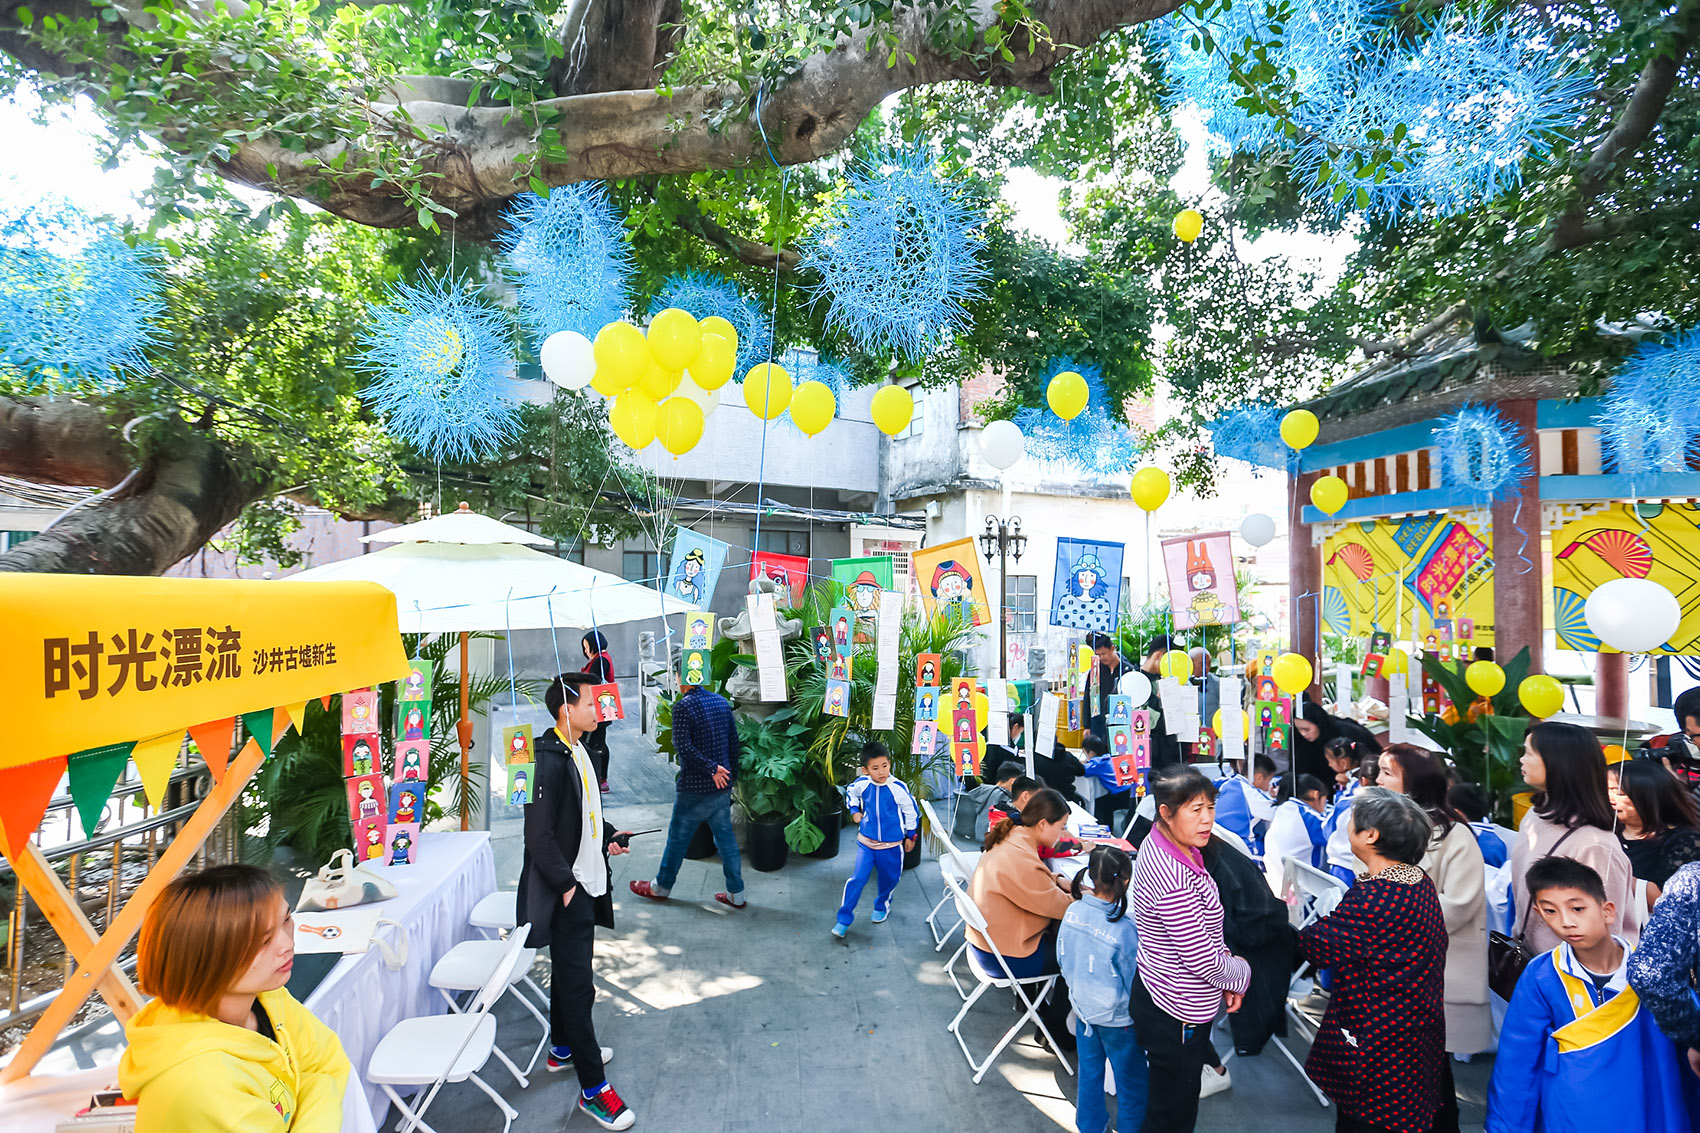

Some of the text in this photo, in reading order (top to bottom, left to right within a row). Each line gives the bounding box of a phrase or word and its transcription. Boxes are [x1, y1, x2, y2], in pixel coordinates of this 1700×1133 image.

[43, 625, 337, 700] 时光漂流 沙井古墟新生
